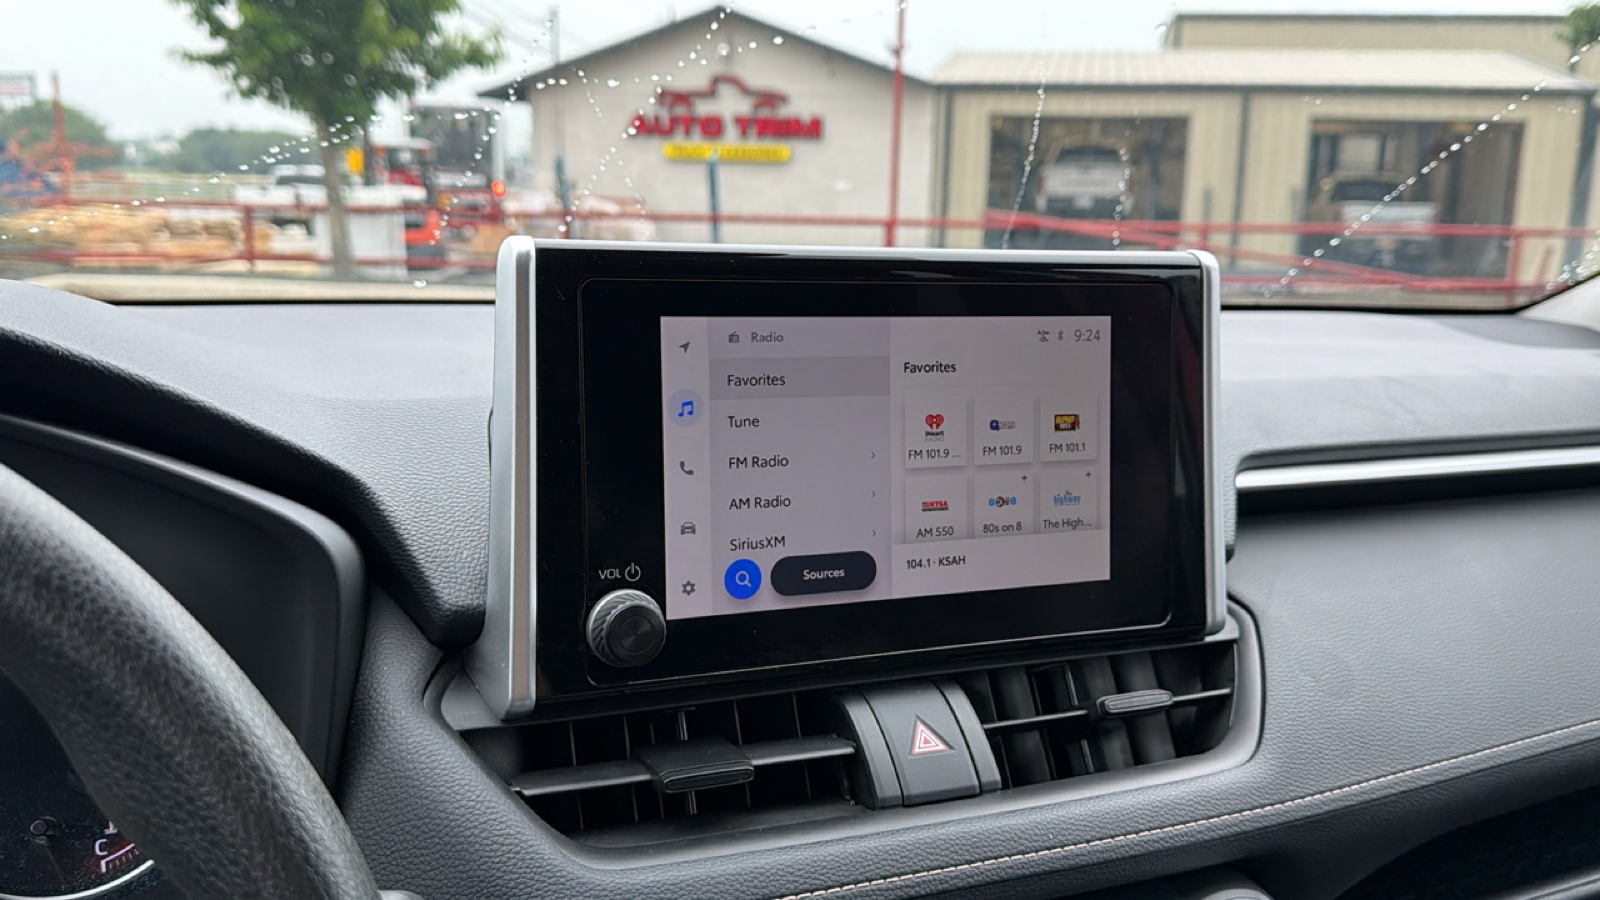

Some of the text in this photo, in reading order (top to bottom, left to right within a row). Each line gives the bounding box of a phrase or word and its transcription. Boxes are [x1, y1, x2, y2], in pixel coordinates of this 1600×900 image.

[629, 114, 822, 139] AUTO TRIM
[750, 331, 784, 343] Radio
[1074, 329, 1101, 342] 9:24
[903, 361, 957, 374] Favorites
[727, 373, 786, 387] Favorites
[727, 415, 760, 428] Tune
[982, 445, 1022, 456] FM 101.9
[1049, 442, 1086, 453] FM 101.1
[908, 449, 923, 460] FM
[728, 455, 789, 469] FM Radio
[729, 495, 791, 510] AM Radio
[982, 522, 1022, 533] 80s on 8
[1043, 519, 1060, 529] The
[916, 526, 955, 539] AM 550
[729, 536, 786, 551] SiriusXM
[906, 555, 966, 570] 104.1 KSAH
[598, 568, 622, 580] VOL
[803, 566, 846, 580] Sources
[94, 838, 109, 856] C
